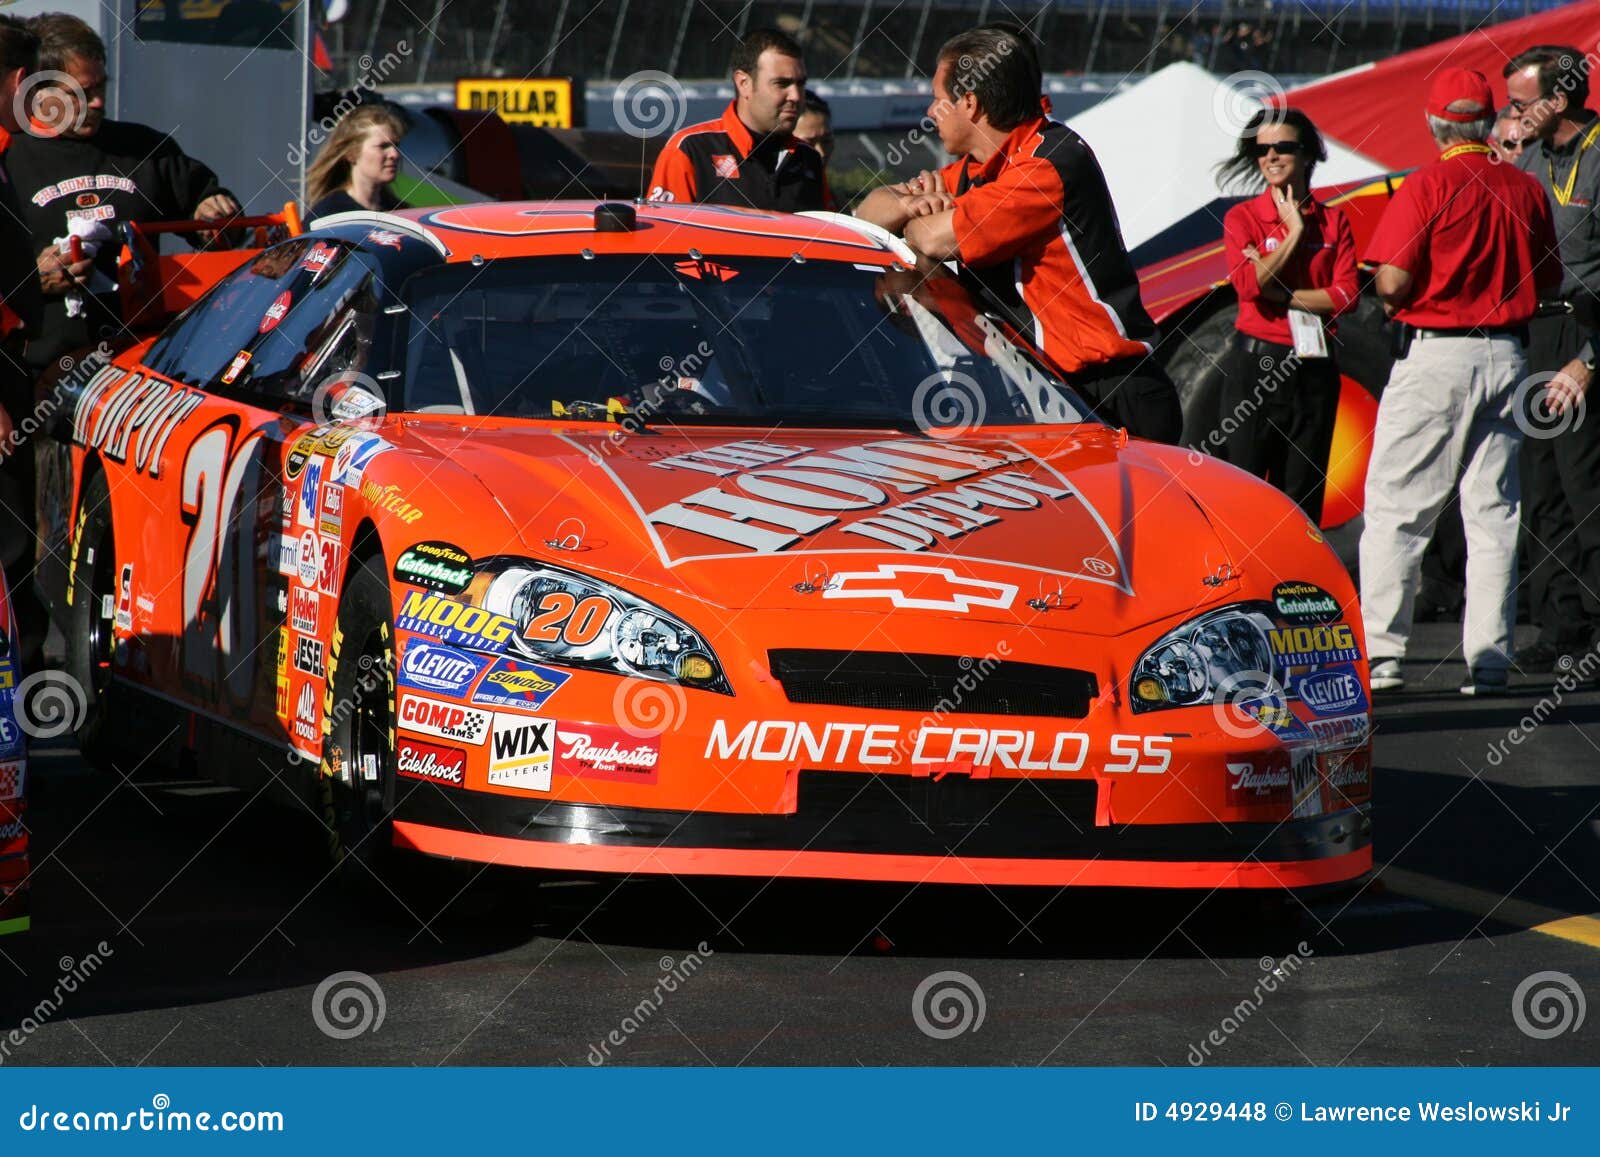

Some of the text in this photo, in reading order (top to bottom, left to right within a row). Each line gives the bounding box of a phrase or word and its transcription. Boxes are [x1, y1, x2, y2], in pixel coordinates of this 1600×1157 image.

[470, 90, 558, 114] DOLLAR
[57, 175, 97, 196] HOME
[648, 440, 815, 477] THE
[361, 479, 424, 525] GOODYEAR
[645, 440, 1032, 553] HOME
[840, 470, 1075, 552] DEPOT
[396, 550, 473, 587] Gatorback
[415, 543, 468, 564] GOODYEAR
[400, 591, 518, 643] MOOG
[523, 592, 612, 646] 20
[1276, 596, 1338, 615] Gatorback
[400, 616, 504, 652] CHASSIS PARTS
[1268, 624, 1355, 656] MOOG
[293, 636, 325, 678] JESEL
[406, 644, 475, 683] CLEVITE
[487, 670, 556, 692] SUNOCO
[1299, 674, 1356, 706] CLEVITE
[402, 698, 475, 741] COMP CAMS
[493, 722, 551, 760] WIX
[556, 730, 658, 771] Raybestos
[704, 719, 899, 764] MONTE
[911, 727, 1090, 772] CARLO
[397, 746, 463, 784] Edelbrock
[490, 763, 550, 781] FILTERS
